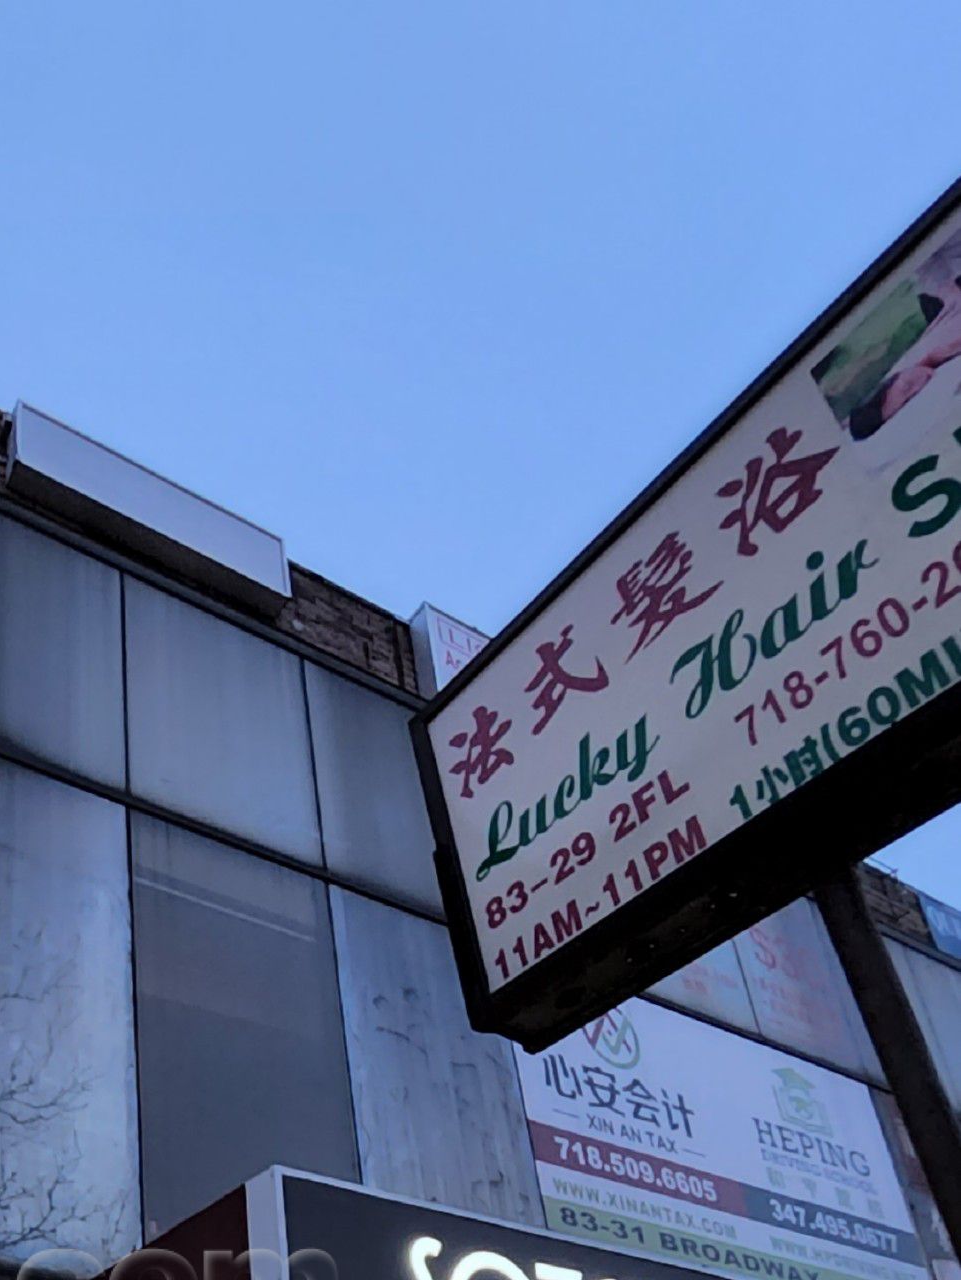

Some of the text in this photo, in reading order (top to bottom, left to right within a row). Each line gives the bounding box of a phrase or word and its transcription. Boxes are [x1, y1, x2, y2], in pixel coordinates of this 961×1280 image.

[475, 424, 961, 882] Lucky Hair S
[485, 540, 961, 930] 83-29 2FL 718-760-2
[495, 815, 708, 979] 11AM~11PM
[543, 1054, 694, 1138] 心安会计
[586, 1113, 679, 1154] XIN AN TAX
[553, 1136, 718, 1202] 718.509.6605
[751, 1117, 871, 1178] HEPING
[559, 1206, 646, 1245] 83-31
